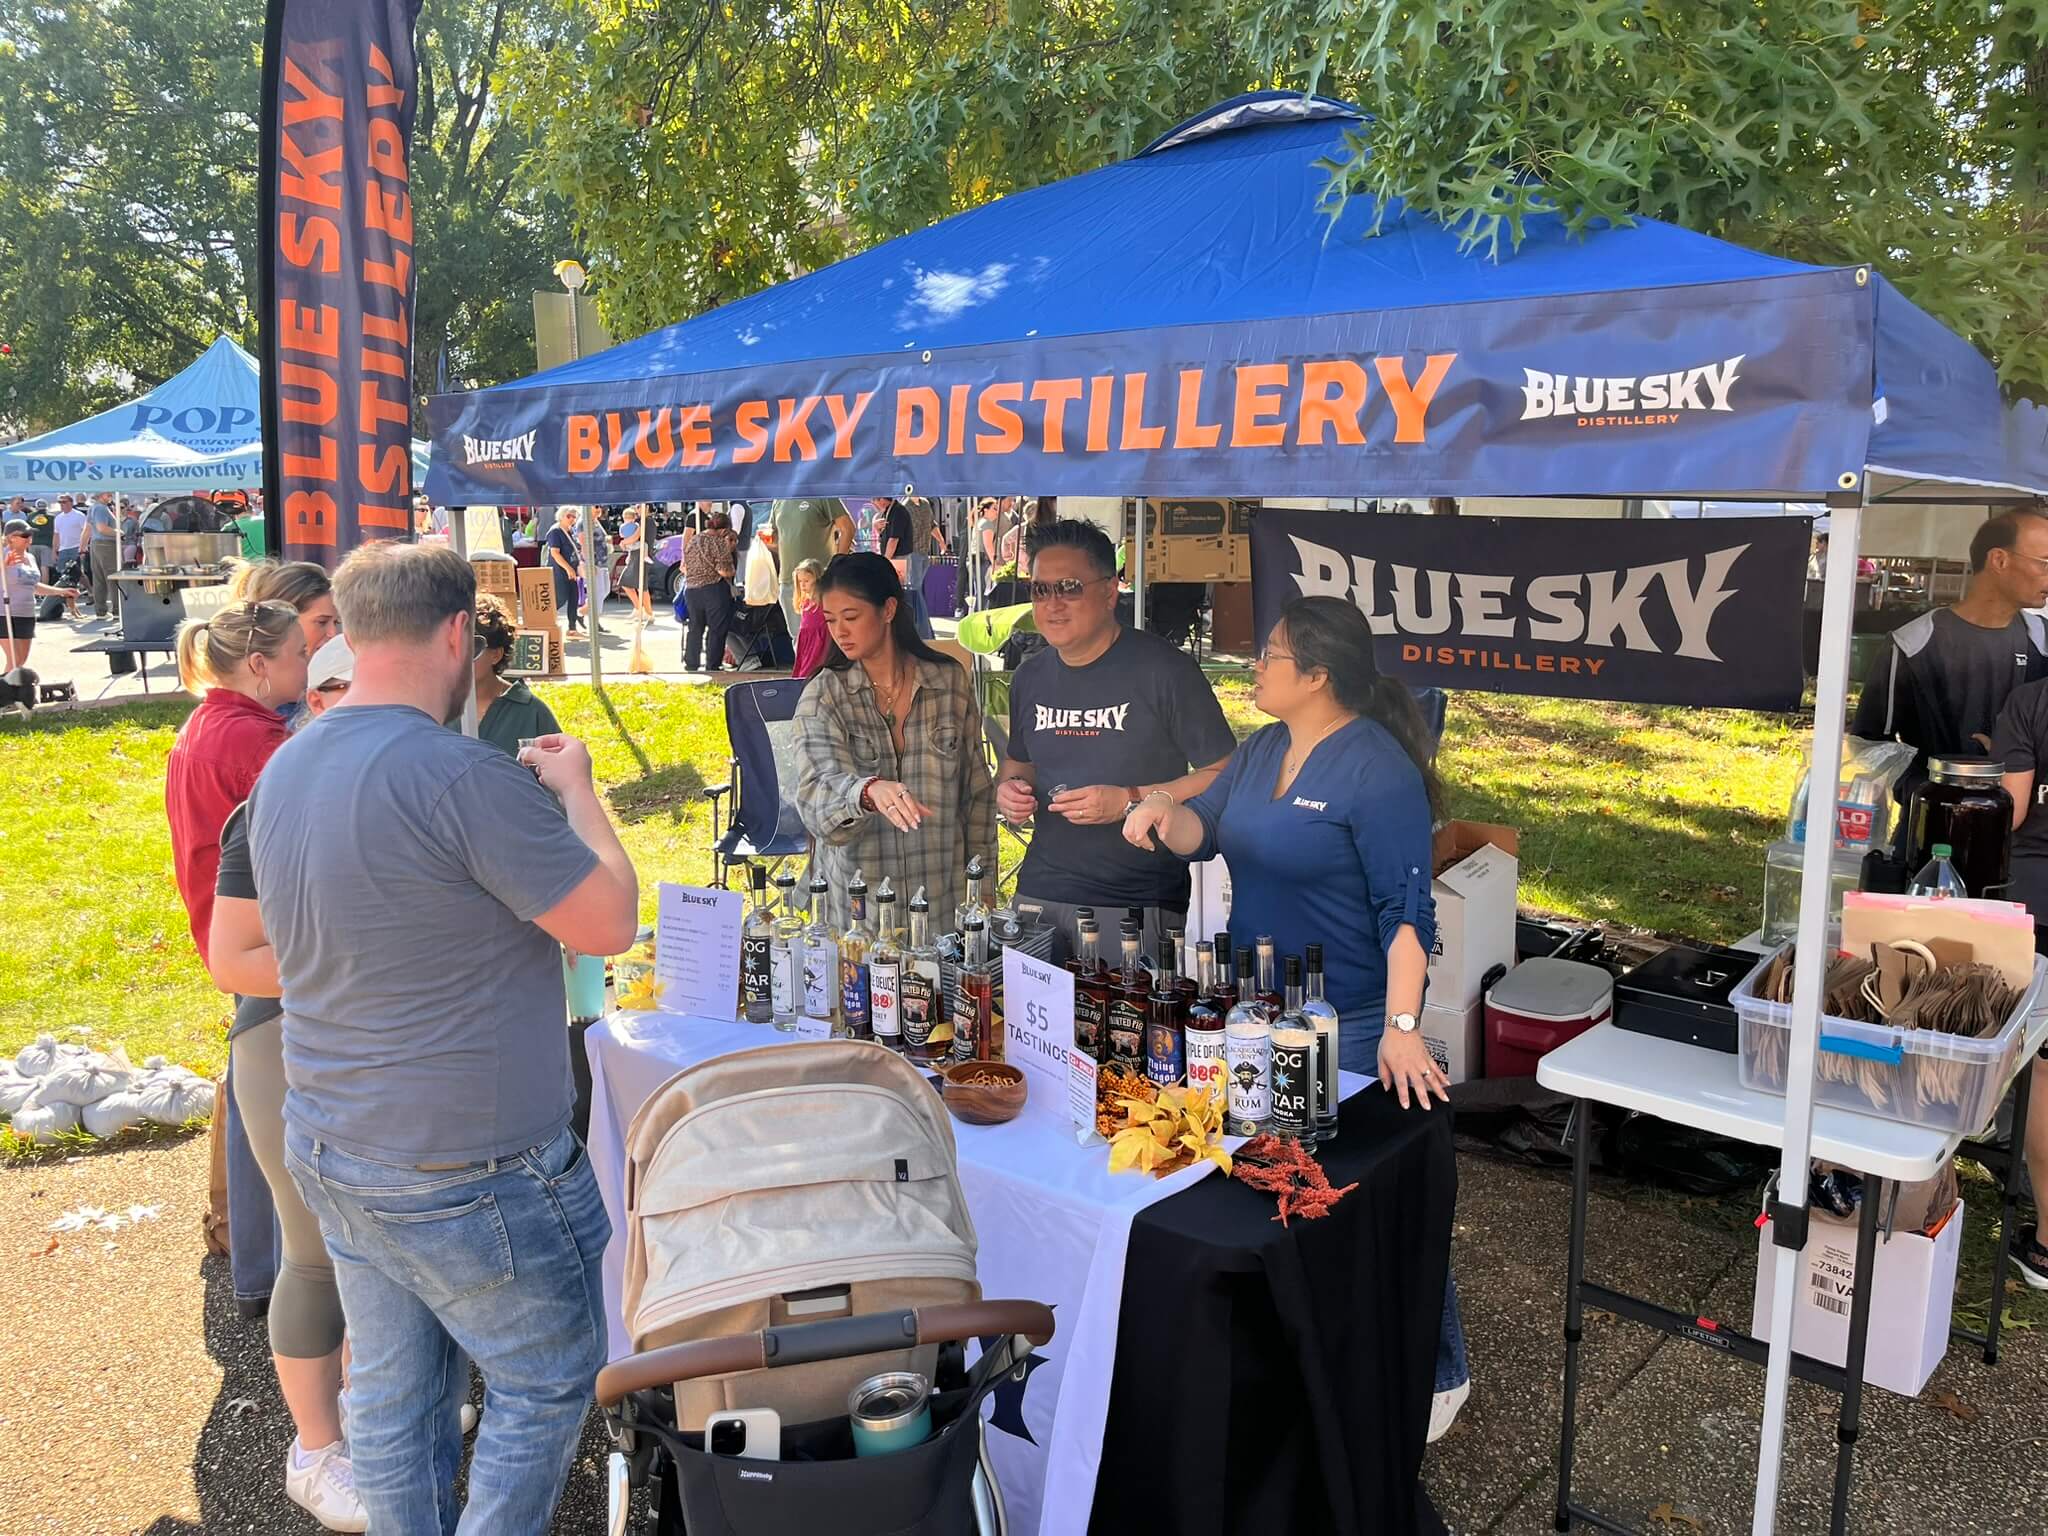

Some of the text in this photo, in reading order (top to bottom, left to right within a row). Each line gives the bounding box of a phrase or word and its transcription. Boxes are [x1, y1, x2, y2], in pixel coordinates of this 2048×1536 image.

[279, 55, 345, 547] BLUE SKY
[357, 41, 413, 547] ISTILLERY
[130, 404, 260, 434] POP
[567, 352, 1458, 473] BLUE SKY DISTILLERY
[1577, 414, 1679, 427] DISTILLERY
[110, 462, 247, 480] Praiseworthy
[1403, 644, 1606, 676] DISTILLERY
[744, 973, 769, 986] TAR
[876, 975, 896, 993] DEUCE
[1026, 999, 1048, 1031] $5
[1008, 1023, 1068, 1065] TASTINGS
[1235, 1097, 1261, 1110] RUM
[1271, 1088, 1306, 1110] TAR
[1819, 1260, 1853, 1280] 73842
[1687, 1328, 1723, 1344] LIFETIME
